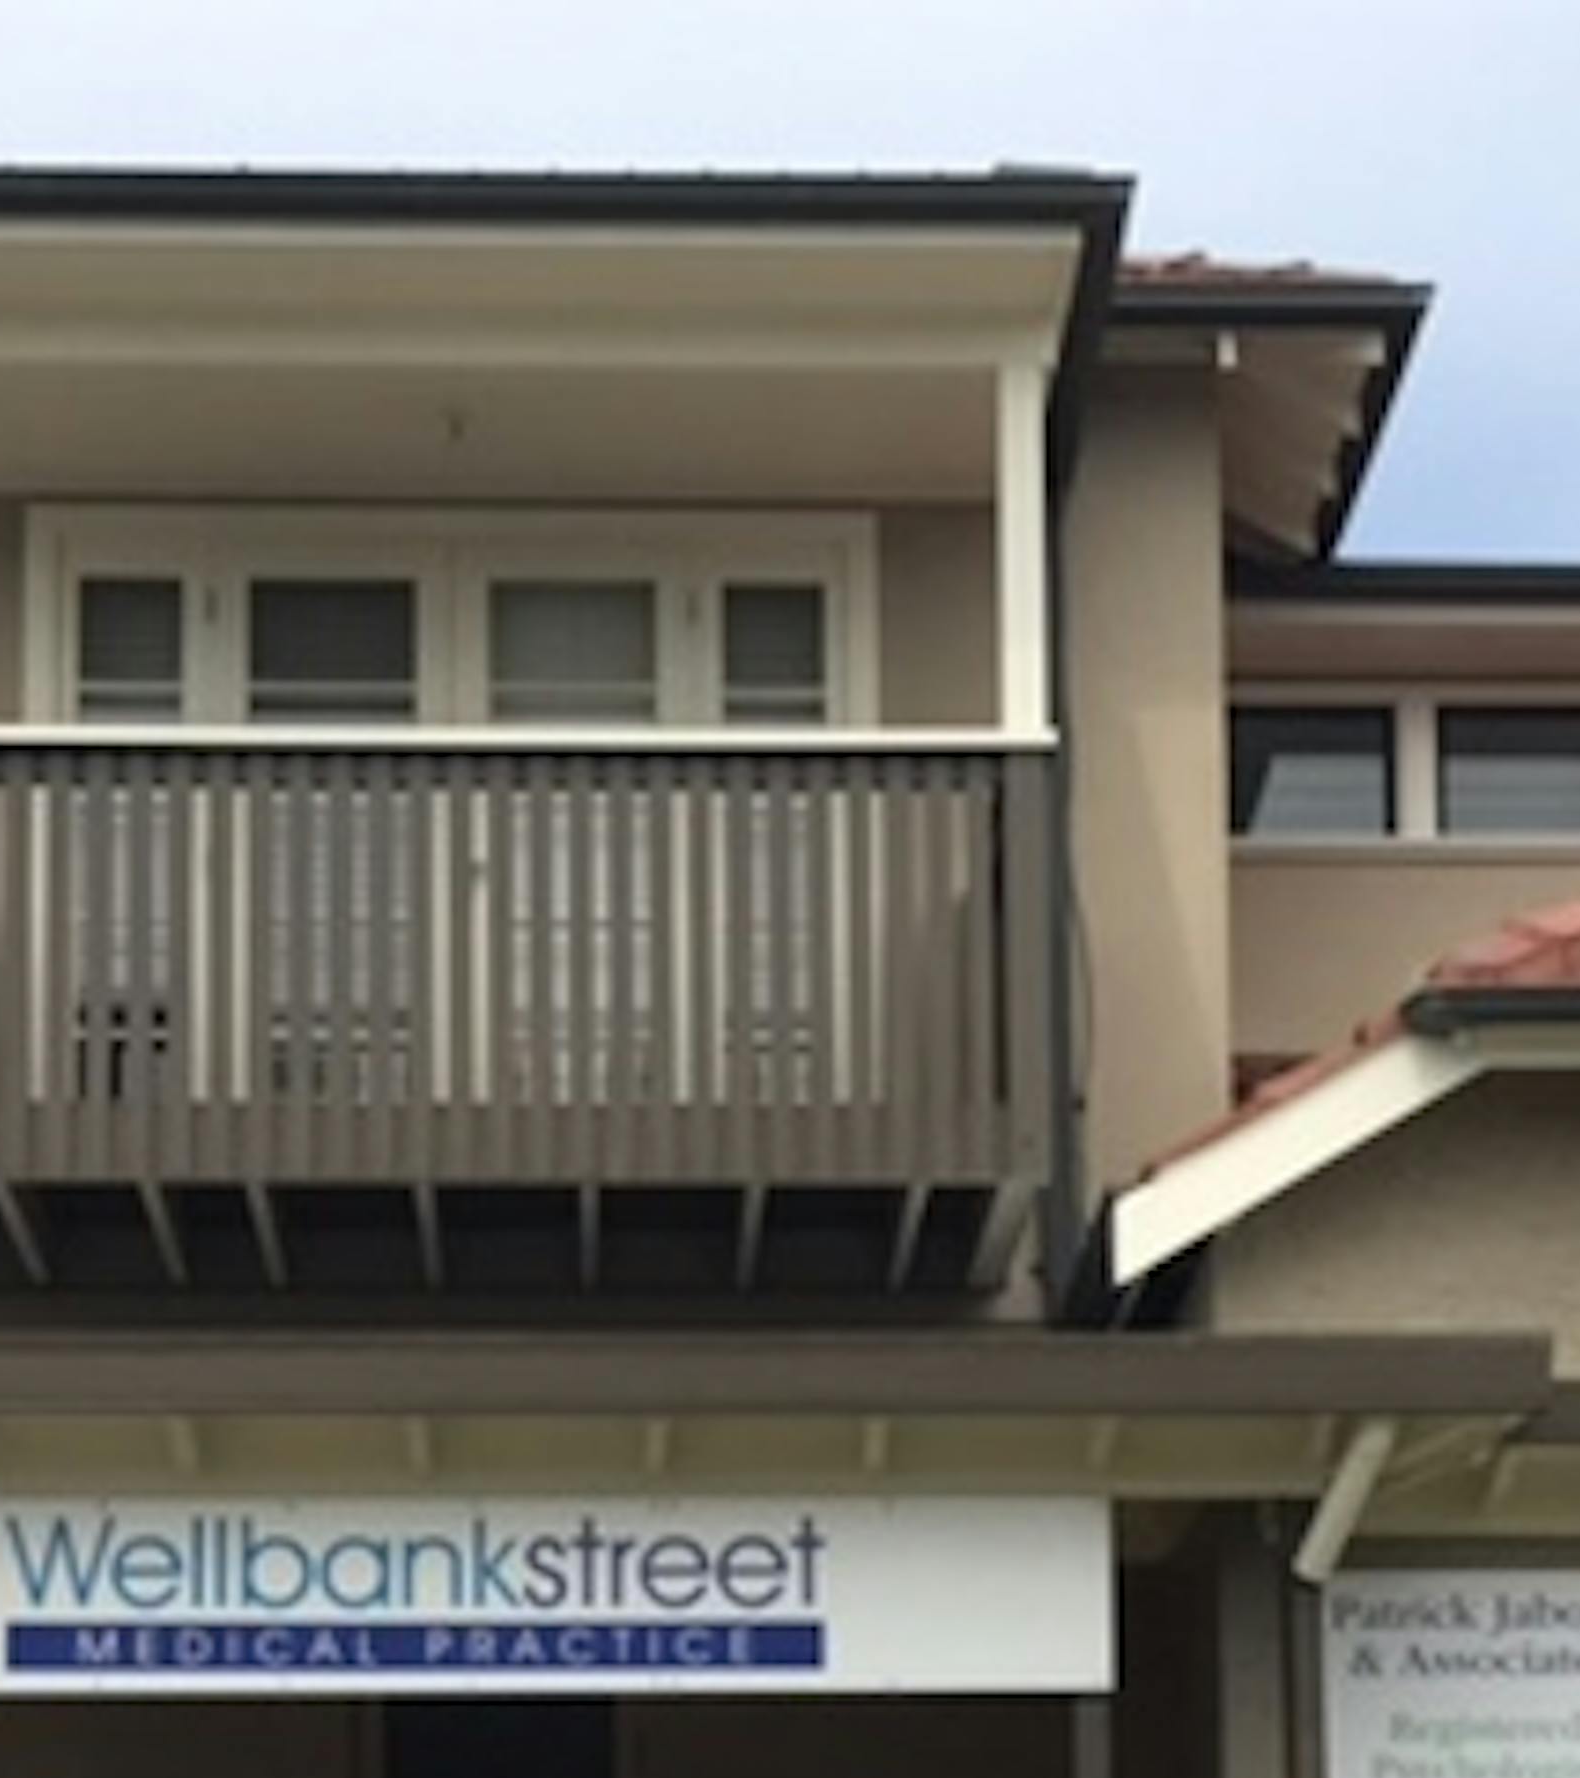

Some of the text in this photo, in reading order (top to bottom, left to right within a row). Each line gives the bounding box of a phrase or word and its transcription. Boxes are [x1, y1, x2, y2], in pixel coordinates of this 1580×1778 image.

[5, 1513, 827, 1609] Wellbankstreet
[1330, 1592, 1479, 1631] Patrick
[74, 1628, 752, 1666] MEDICAL PRACTICE
[1349, 1644, 1383, 1678] &
